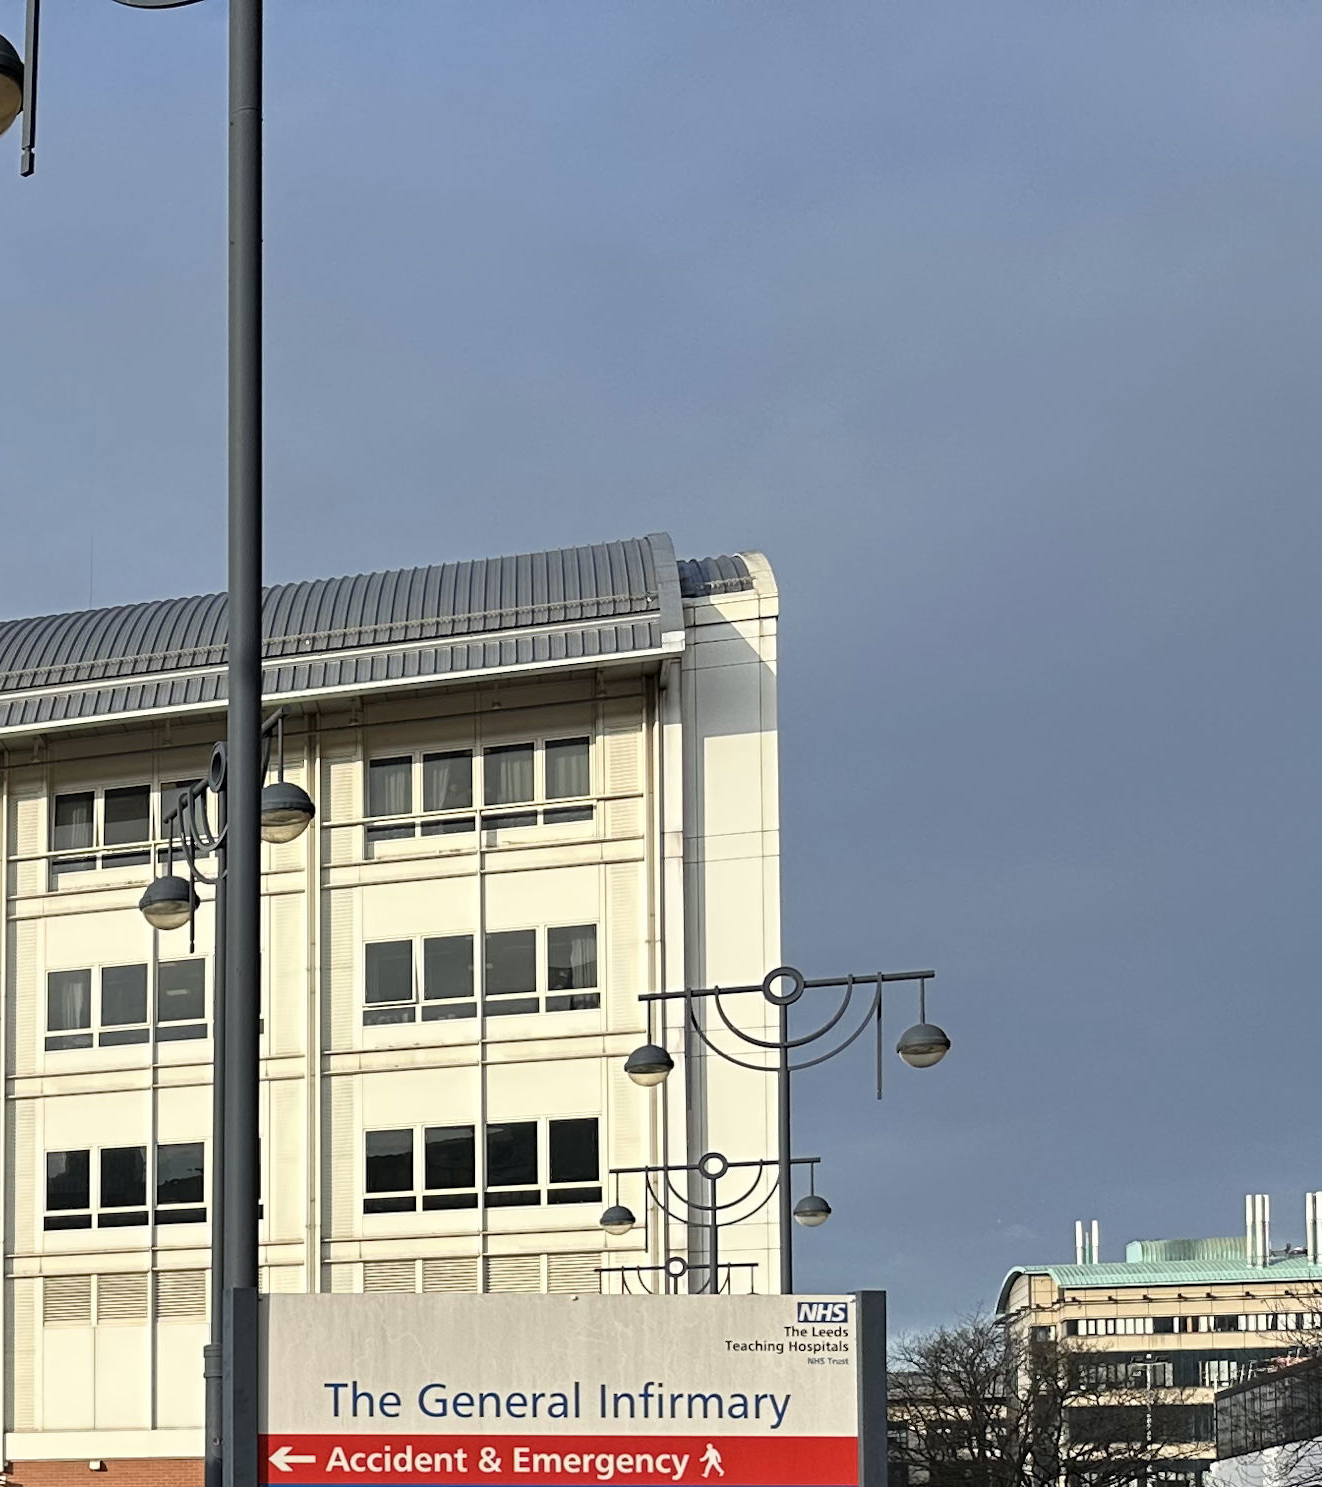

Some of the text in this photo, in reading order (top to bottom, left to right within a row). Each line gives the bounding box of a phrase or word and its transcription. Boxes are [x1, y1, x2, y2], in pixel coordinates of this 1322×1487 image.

[798, 1303, 846, 1322] NHS
[784, 1326, 849, 1337] The Leeds
[725, 1340, 849, 1354] Teaching Hospitals
[808, 1357, 849, 1366] NHS Trust
[324, 1381, 792, 1429] The General Infirmary
[325, 1446, 690, 1481] Accident & Emergency
